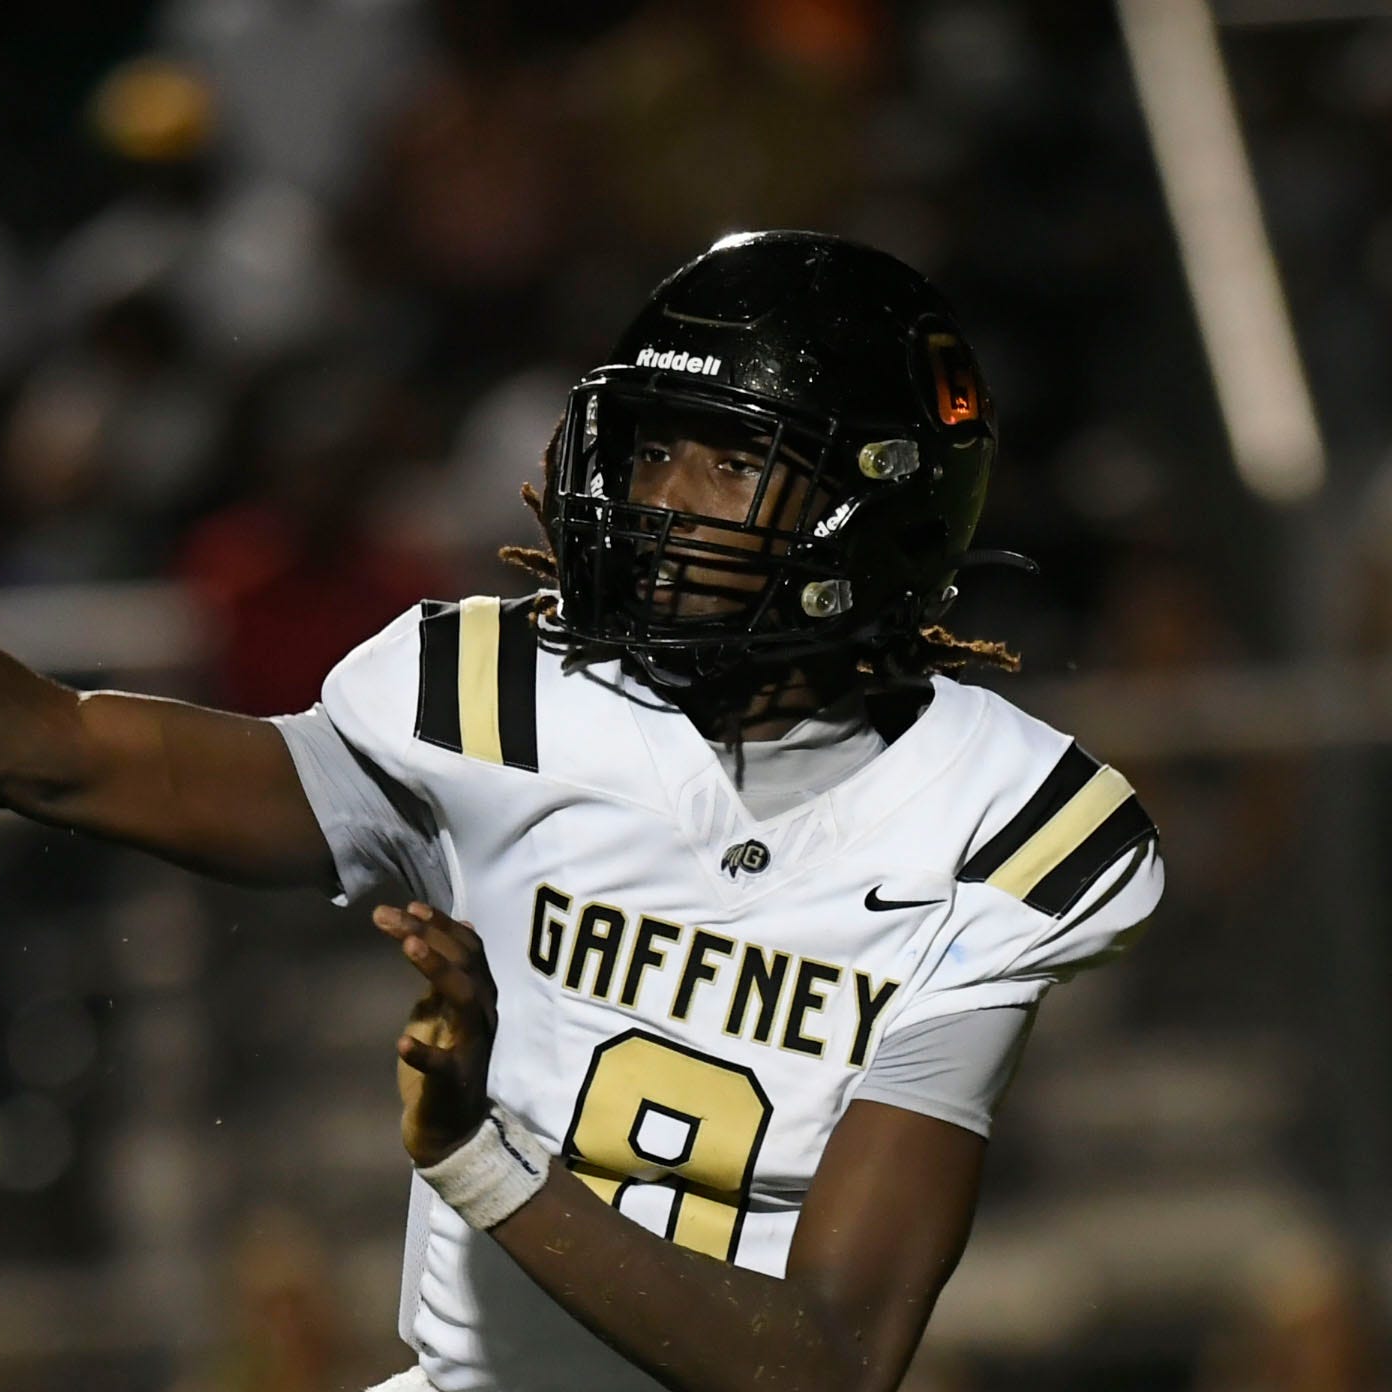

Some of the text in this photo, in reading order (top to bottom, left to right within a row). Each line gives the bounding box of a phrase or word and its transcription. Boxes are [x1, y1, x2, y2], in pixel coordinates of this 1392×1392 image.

[636, 348, 722, 376] Riddell
[741, 844, 766, 869] G
[526, 881, 902, 1071] GAFFNEY
[561, 1027, 775, 1266] 8
